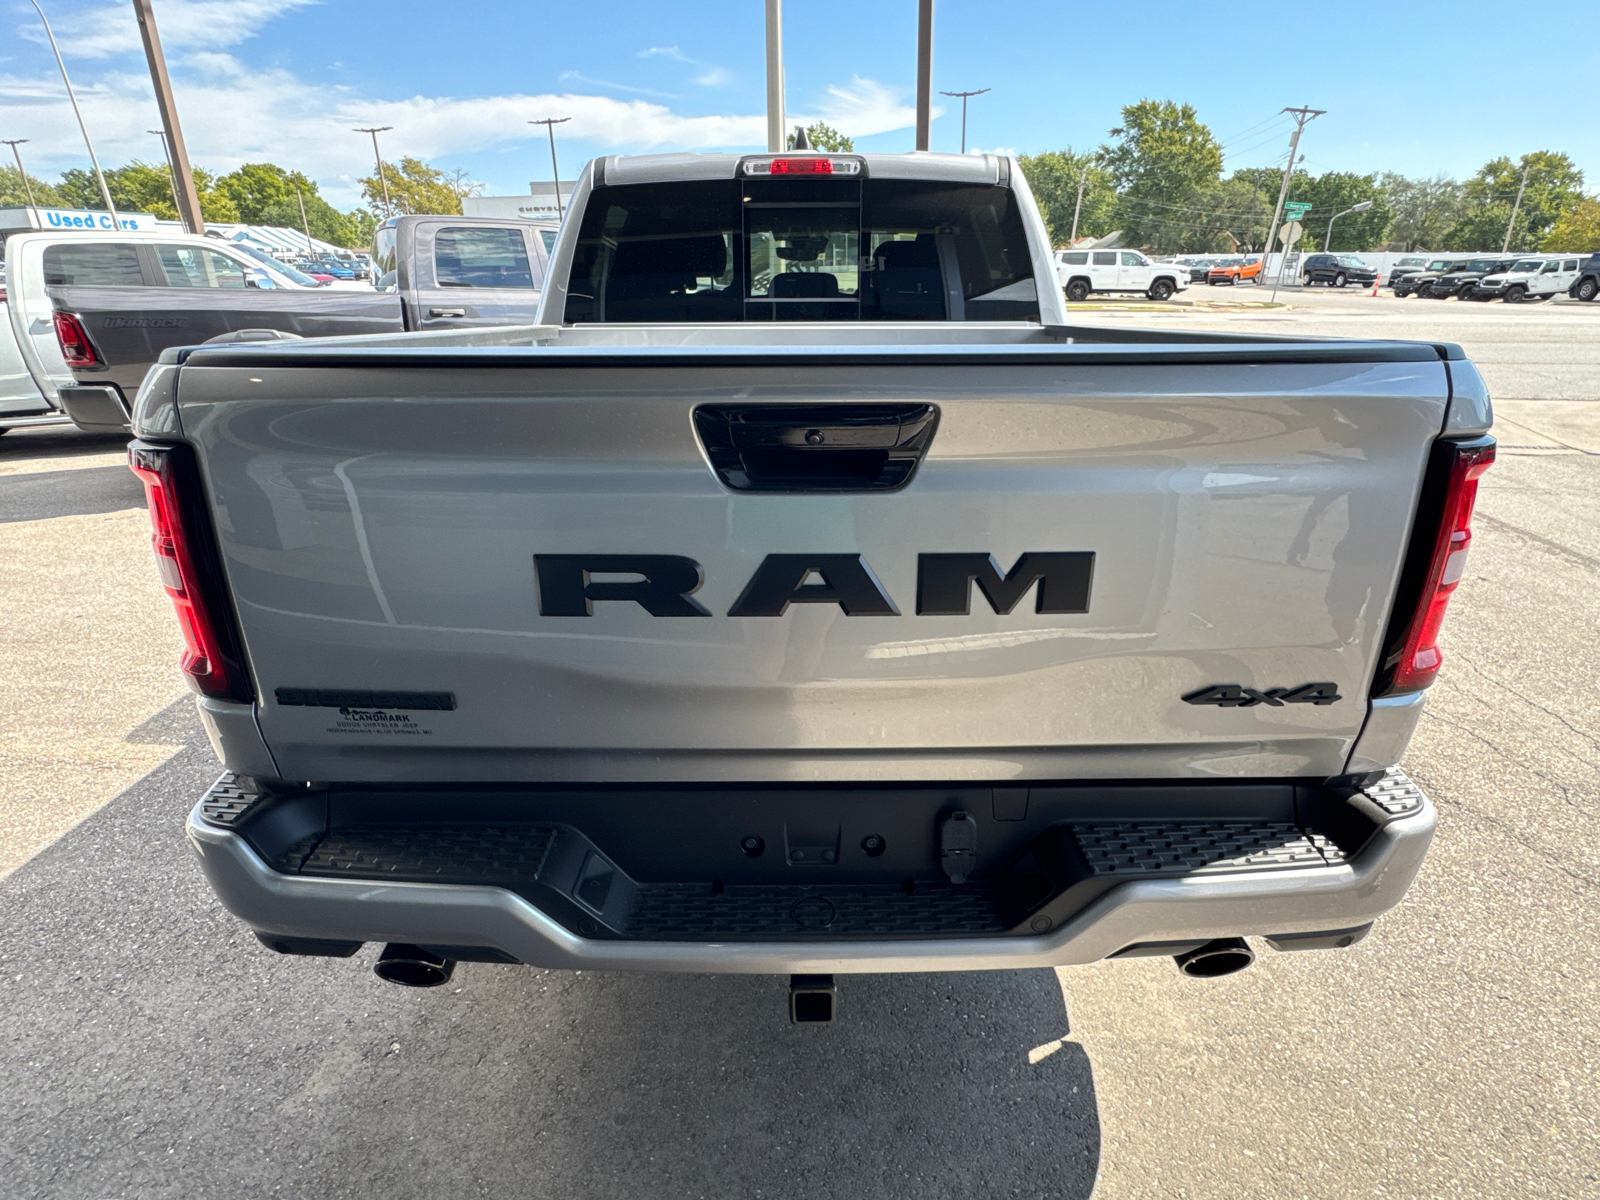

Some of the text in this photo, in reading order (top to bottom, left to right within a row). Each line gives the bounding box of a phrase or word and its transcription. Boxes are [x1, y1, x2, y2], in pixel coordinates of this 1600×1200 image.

[46, 212, 96, 229] Used
[533, 551, 1097, 618] RAM
[351, 714, 411, 722] LANDMARK
